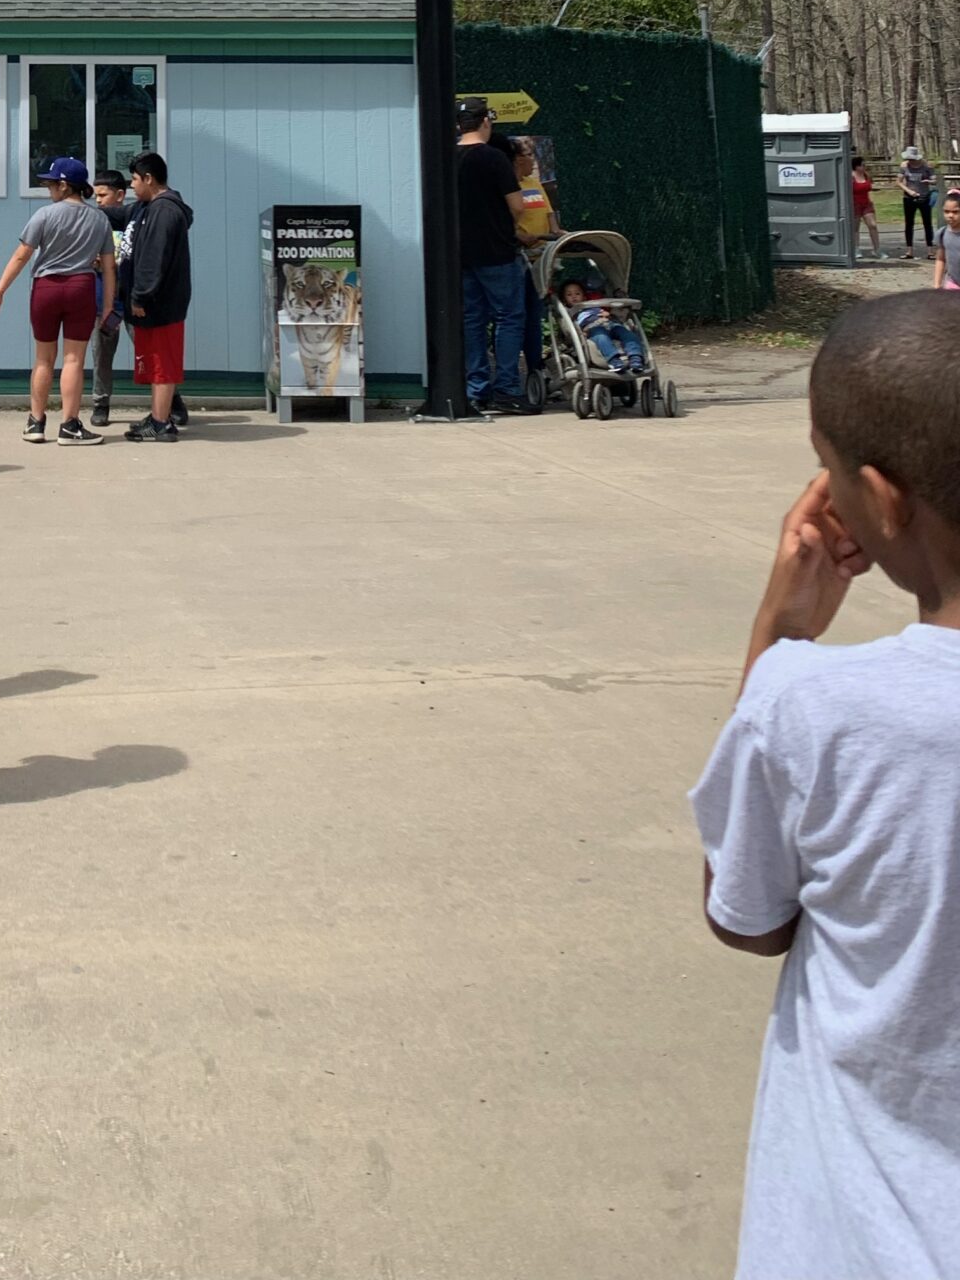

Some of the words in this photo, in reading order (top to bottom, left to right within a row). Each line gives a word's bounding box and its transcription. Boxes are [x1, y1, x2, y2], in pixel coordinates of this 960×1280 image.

[286, 218, 305, 226] Cape
[306, 218, 321, 226] May
[322, 218, 350, 226] County
[277, 246, 298, 258] ZOO
[299, 246, 355, 258] DONATIONS
